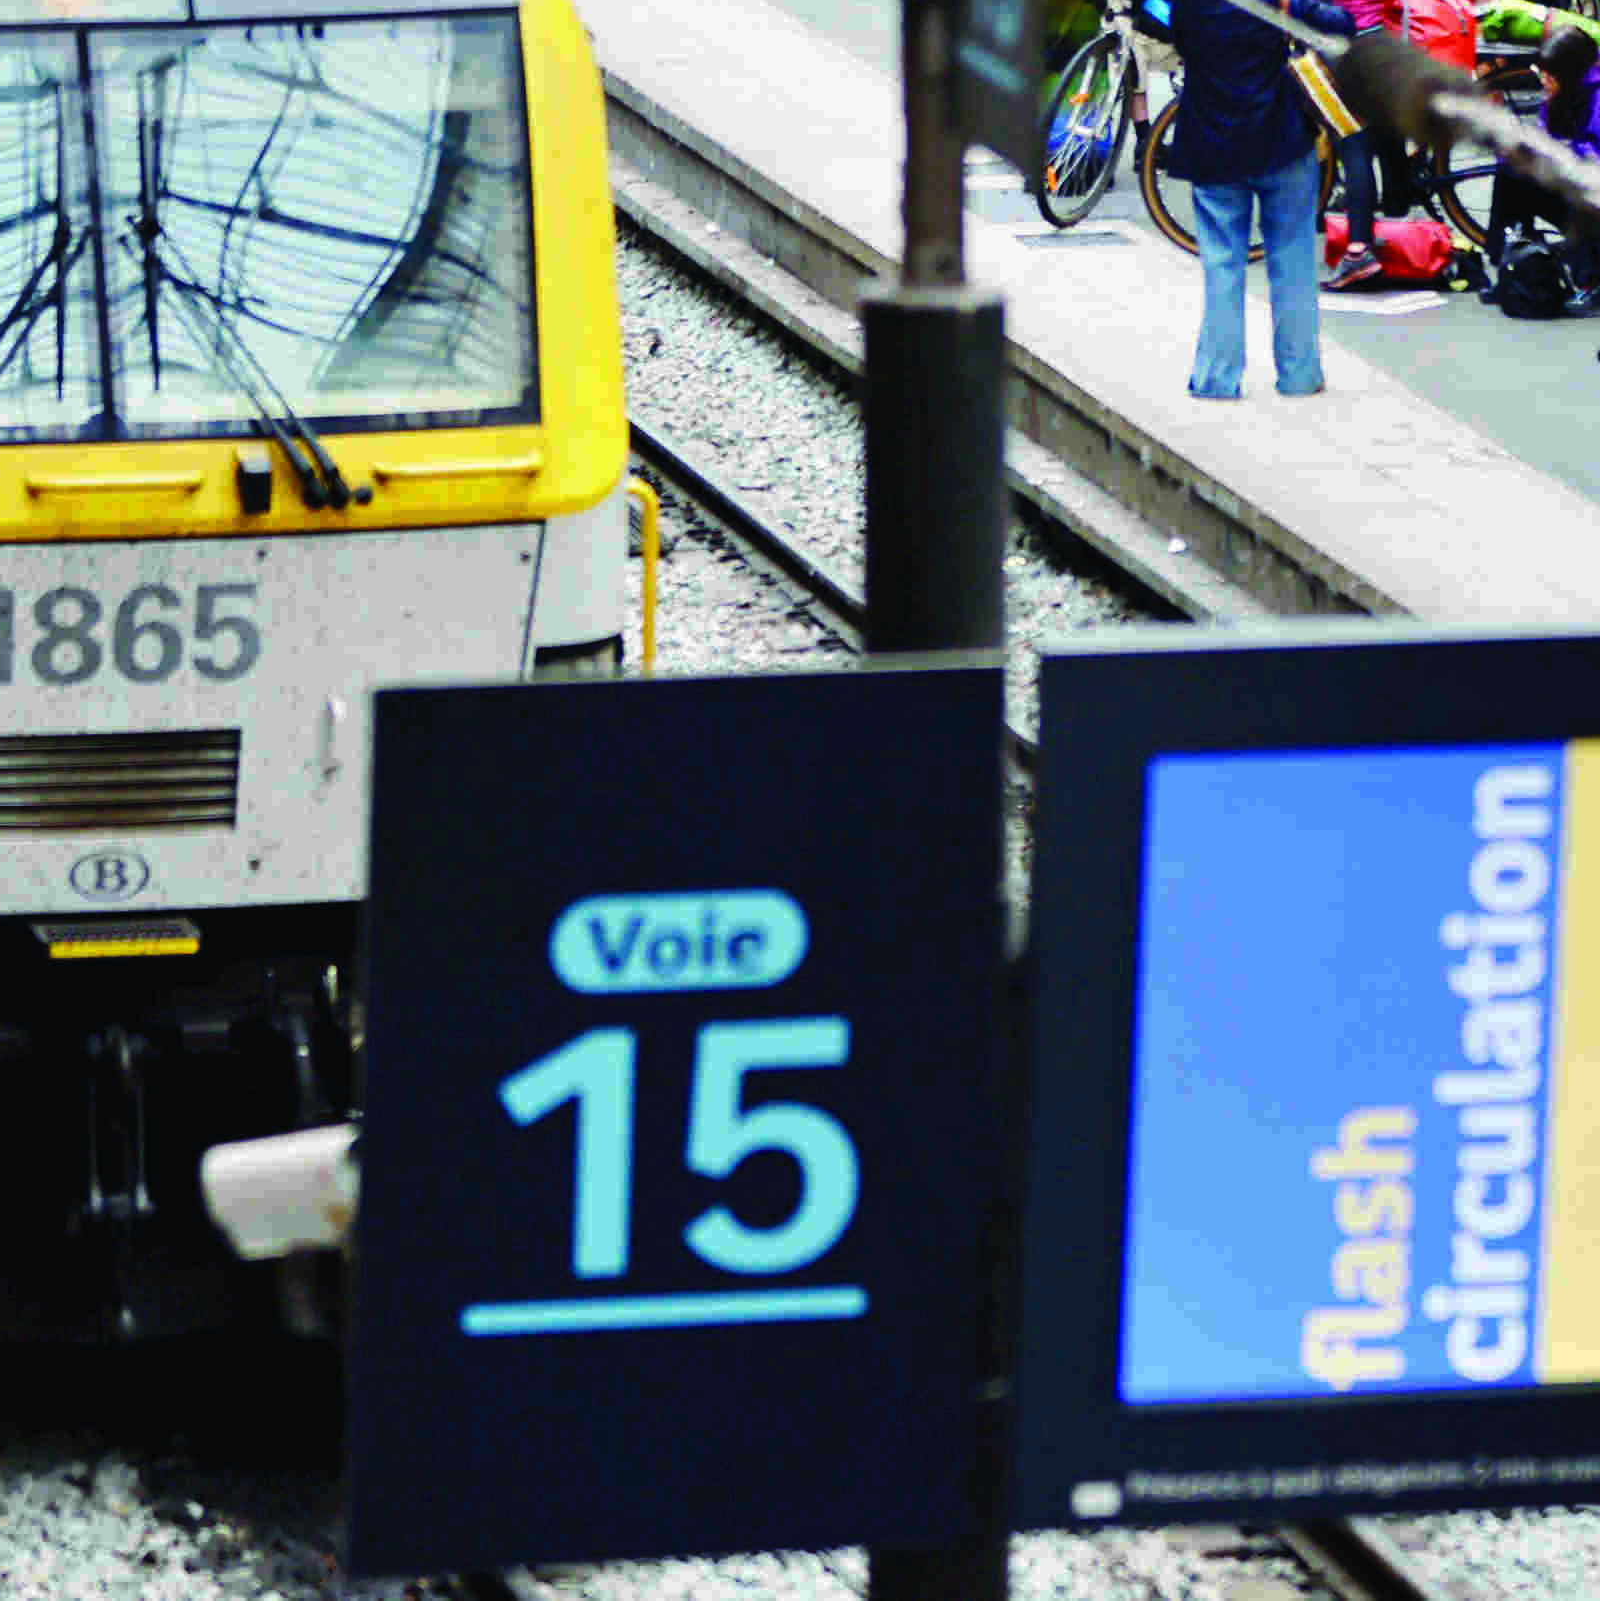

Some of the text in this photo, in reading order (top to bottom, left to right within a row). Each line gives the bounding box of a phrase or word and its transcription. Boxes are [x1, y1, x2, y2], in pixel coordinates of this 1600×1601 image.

[584, 910, 772, 975] Voie
[1423, 762, 1555, 1384] circulation
[496, 1014, 862, 1282] 15
[1302, 1104, 1419, 1394] flash
